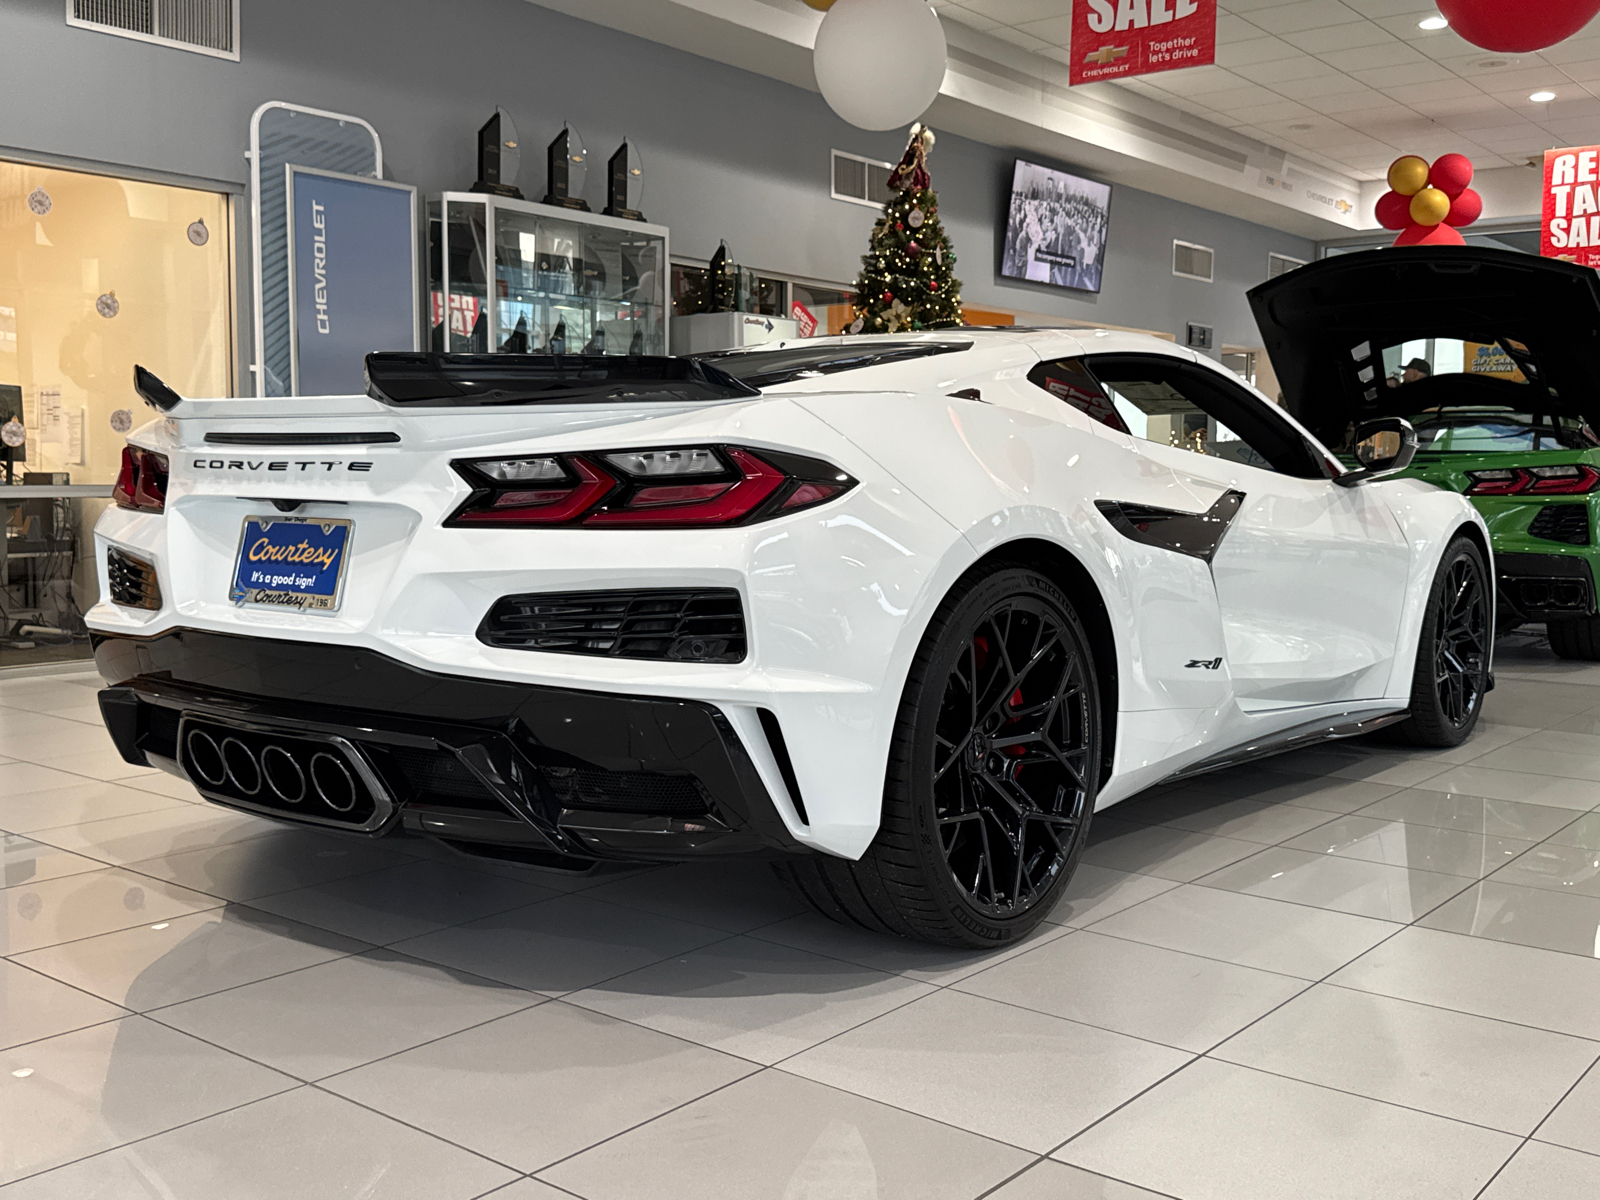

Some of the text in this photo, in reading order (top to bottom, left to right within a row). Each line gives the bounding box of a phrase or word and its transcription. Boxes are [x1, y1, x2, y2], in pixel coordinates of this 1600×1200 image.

[1149, 37, 1196, 52] Together
[1149, 47, 1198, 63] let's drive
[1082, 64, 1130, 78] CHEVROLET
[1552, 151, 1600, 186] RE
[1306, 190, 1333, 206] CHEVROLET
[1551, 183, 1600, 217] TA
[1550, 216, 1600, 248] SAL
[312, 200, 330, 334] CHEVROLET
[1471, 365, 1517, 373] GIVEAWAY
[193, 459, 374, 472] CORVETTE
[249, 538, 339, 571] Courtesy
[251, 571, 264, 582] It's
[271, 573, 295, 587] good
[295, 574, 316, 589] sign!
[254, 589, 307, 610] Courtesy
[1038, 580, 1079, 622] MICHELIN
[1183, 657, 1223, 670] ZR1
[1081, 692, 1089, 743] CORVETTE
[951, 906, 1000, 939] MICHELIN
